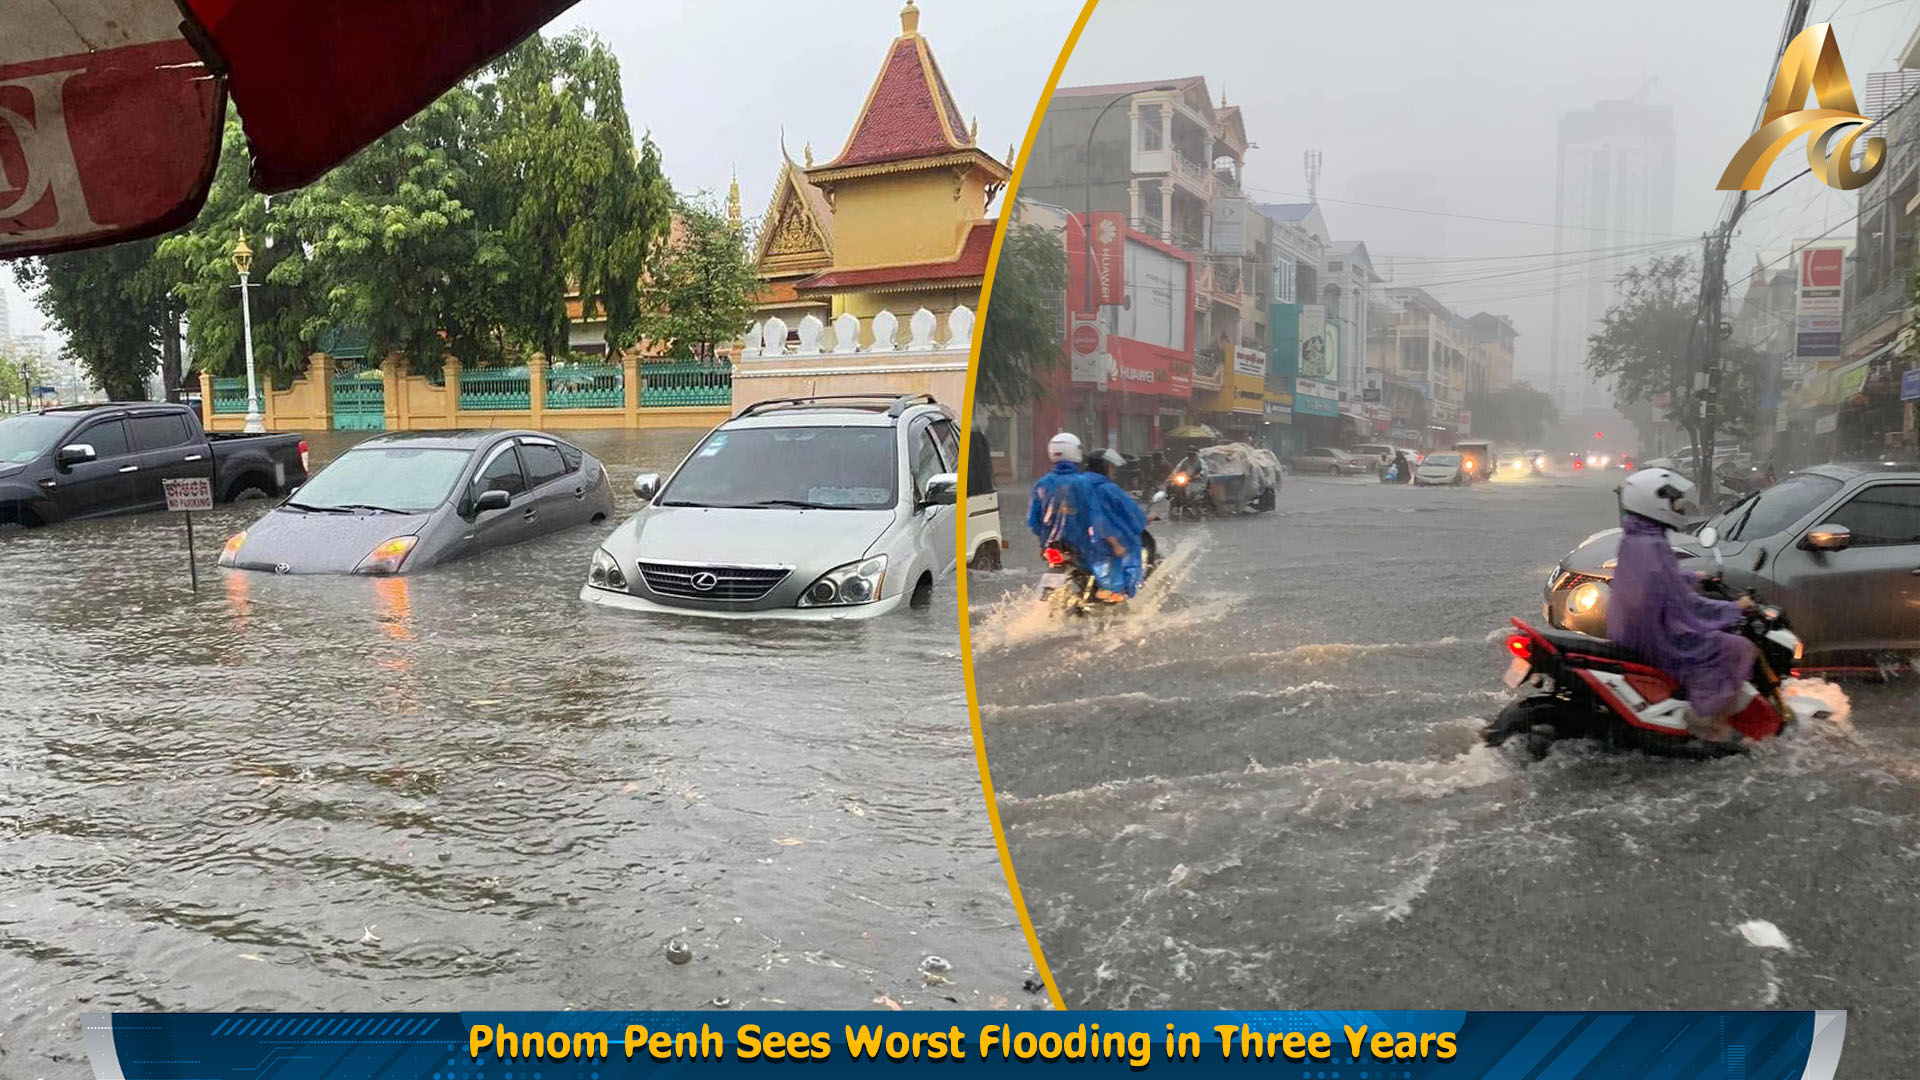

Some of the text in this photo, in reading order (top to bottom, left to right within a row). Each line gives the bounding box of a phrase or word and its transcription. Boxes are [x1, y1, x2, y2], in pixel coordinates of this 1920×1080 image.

[1101, 248, 1111, 302] HUAWEI
[1120, 365, 1155, 384] HUAWEI
[169, 497, 212, 508] NO PARKING
